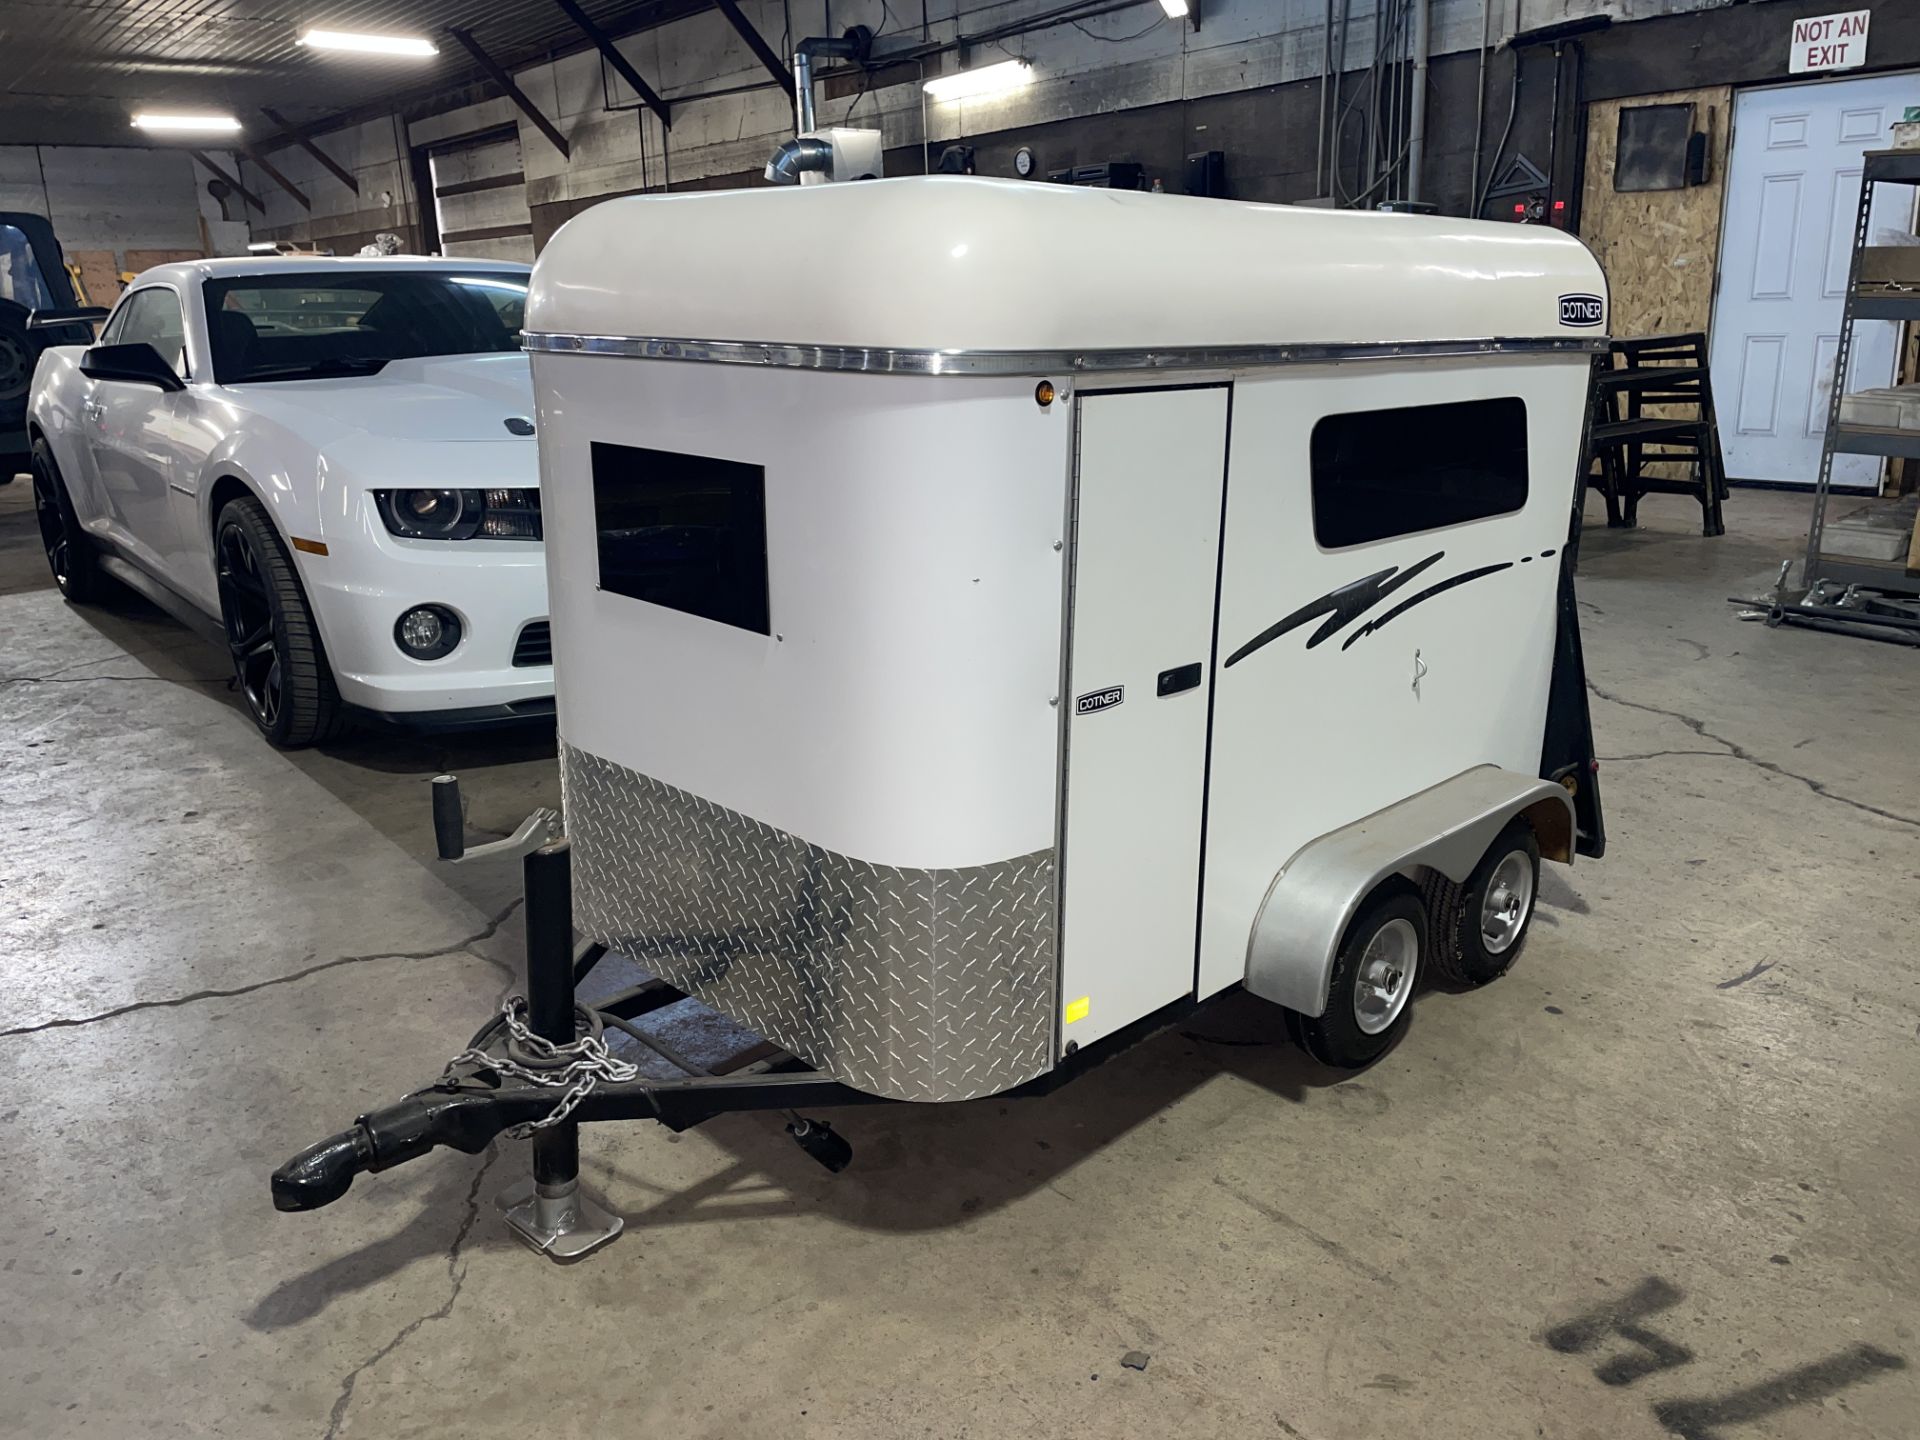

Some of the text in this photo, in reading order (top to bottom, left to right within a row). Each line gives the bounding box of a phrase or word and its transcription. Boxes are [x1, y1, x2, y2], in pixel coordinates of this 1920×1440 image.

[1795, 14, 1867, 43] NOT AN
[1808, 43, 1849, 67] EXIT
[1562, 302, 1601, 319] COTNER
